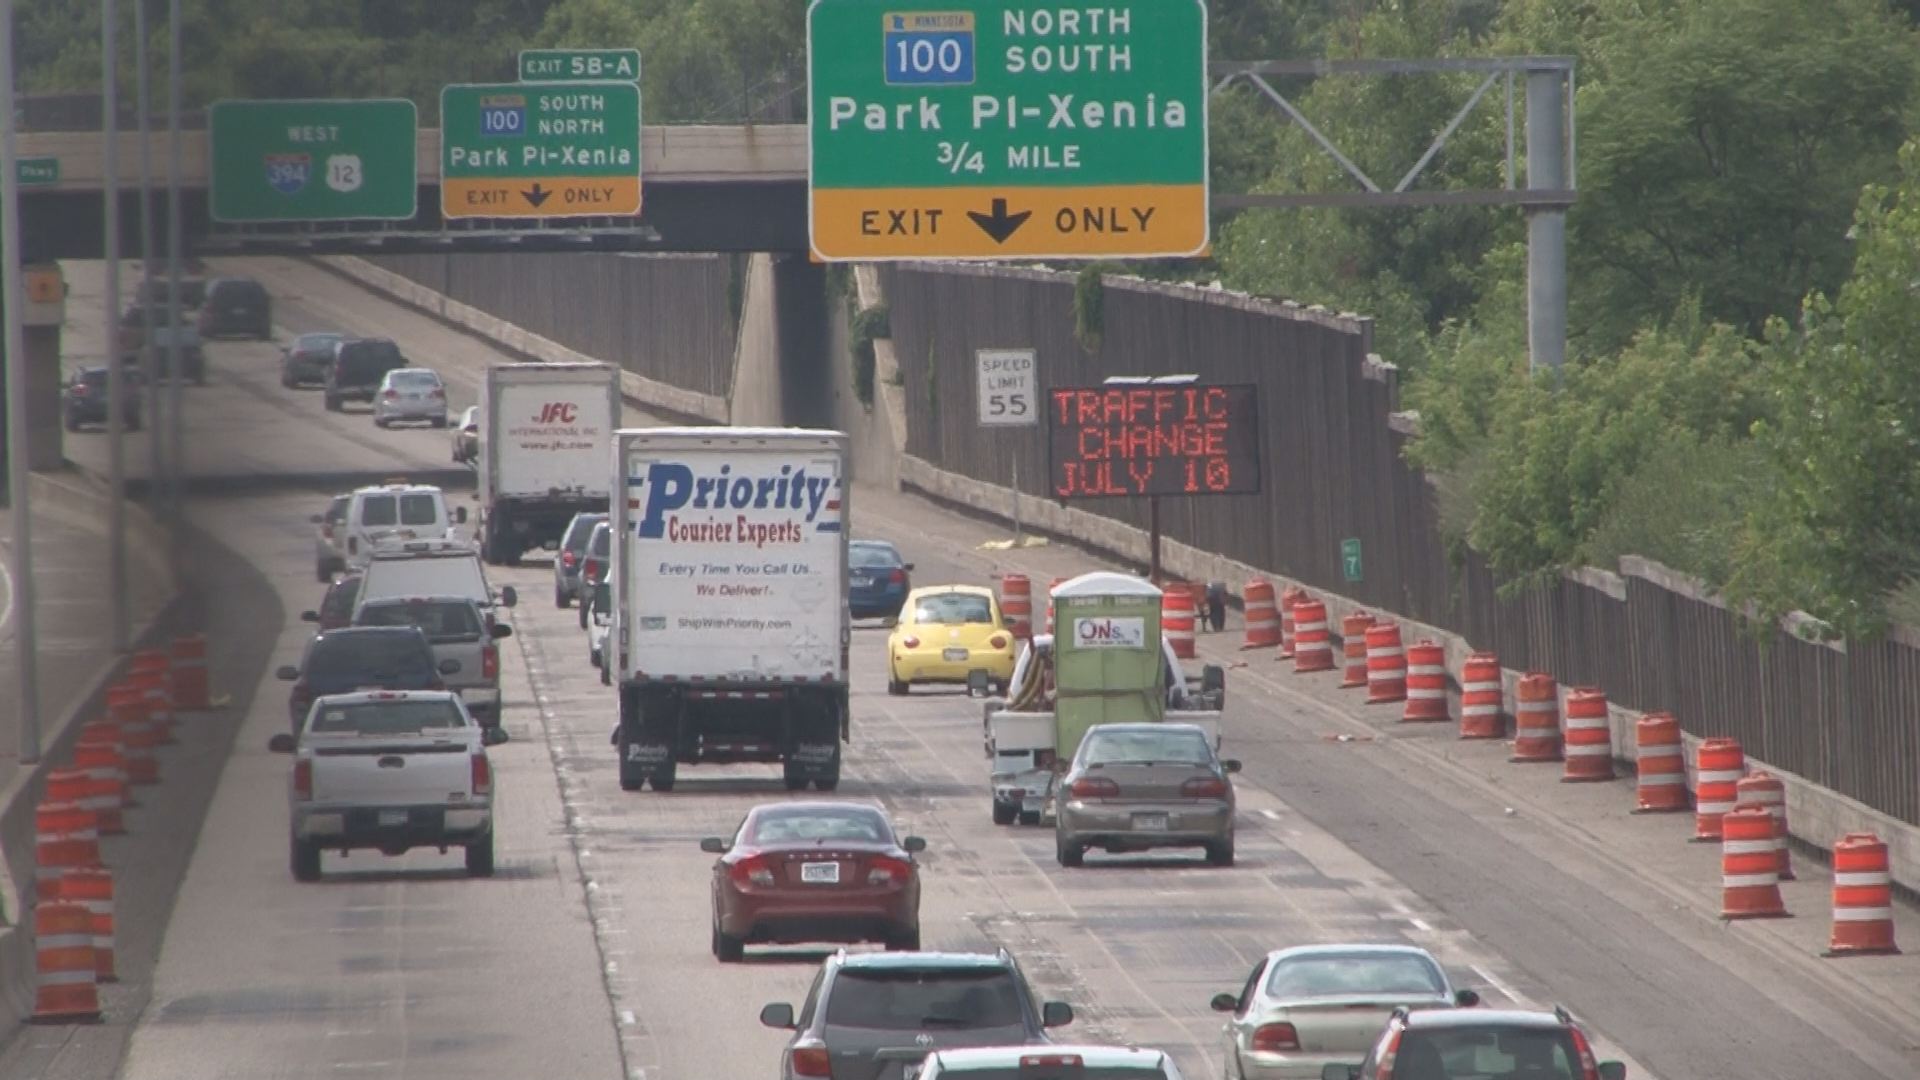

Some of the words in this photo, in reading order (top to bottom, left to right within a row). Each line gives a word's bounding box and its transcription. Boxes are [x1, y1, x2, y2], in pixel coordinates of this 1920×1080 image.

[1003, 8, 1131, 36] NORTH
[526, 60, 562, 73] EXIT
[571, 57, 632, 75] 5B-A
[896, 39, 962, 74] 100
[1005, 45, 1132, 72] SOUTH
[539, 95, 605, 111] SOUTH
[829, 96, 941, 130] Park
[485, 110, 520, 130] 100
[539, 120, 605, 134] NORTH
[287, 126, 339, 142] WEST
[451, 147, 508, 166] Park
[1008, 145, 1081, 168] MILE
[271, 164, 305, 183] 394
[334, 165, 355, 184] 12
[467, 189, 509, 204] EXIT
[564, 188, 614, 203] ONLY
[861, 210, 943, 236] EXIT
[1055, 207, 1156, 234] ONLY
[982, 358, 1031, 372] SPEED
[988, 376, 1025, 390] LIMIT
[531, 402, 578, 423] JFC
[989, 394, 1028, 416] 55
[1054, 387, 1228, 425] TRAFFIC
[1078, 422, 1228, 460] CHANGE
[1056, 461, 1154, 497] JULY
[1184, 458, 1230, 492] 10
[638, 463, 830, 539] Priority
[669, 515, 732, 543] Courier
[737, 515, 801, 548] Experts
[659, 562, 696, 577] Every
[702, 562, 730, 575] Time
[736, 563, 760, 575] You
[763, 563, 788, 575] Call
[1346, 556, 1357, 576] 7
[696, 584, 716, 596] We
